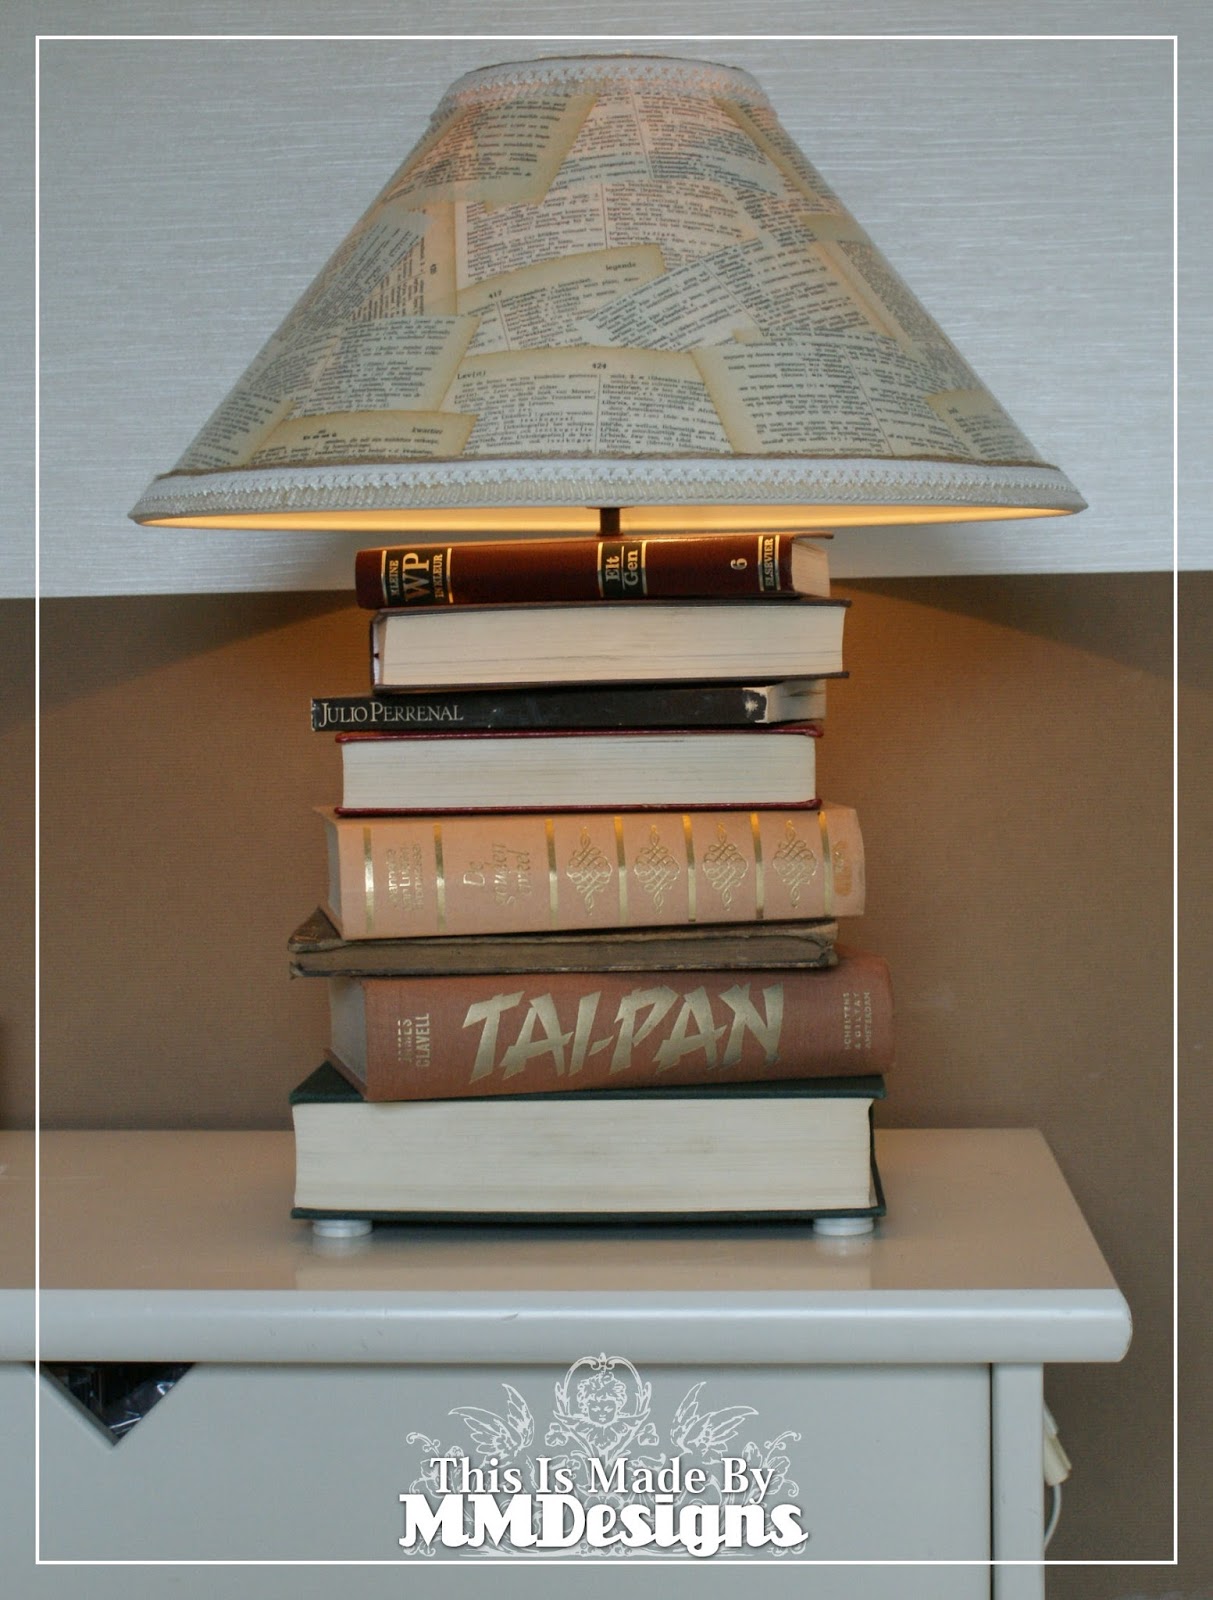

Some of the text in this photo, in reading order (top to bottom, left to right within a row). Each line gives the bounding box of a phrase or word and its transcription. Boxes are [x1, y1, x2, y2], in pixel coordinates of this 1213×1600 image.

[389, 560, 400, 597] KLEINE
[401, 552, 430, 602] WP
[605, 555, 620, 582] Elt
[623, 550, 639, 586] Gen
[730, 557, 748, 571] 6
[319, 702, 464, 727] JULIO PERRENAL
[463, 861, 485, 887] De
[415, 1012, 431, 1068] CLAVELL
[462, 982, 784, 1084] TAI-PAN
